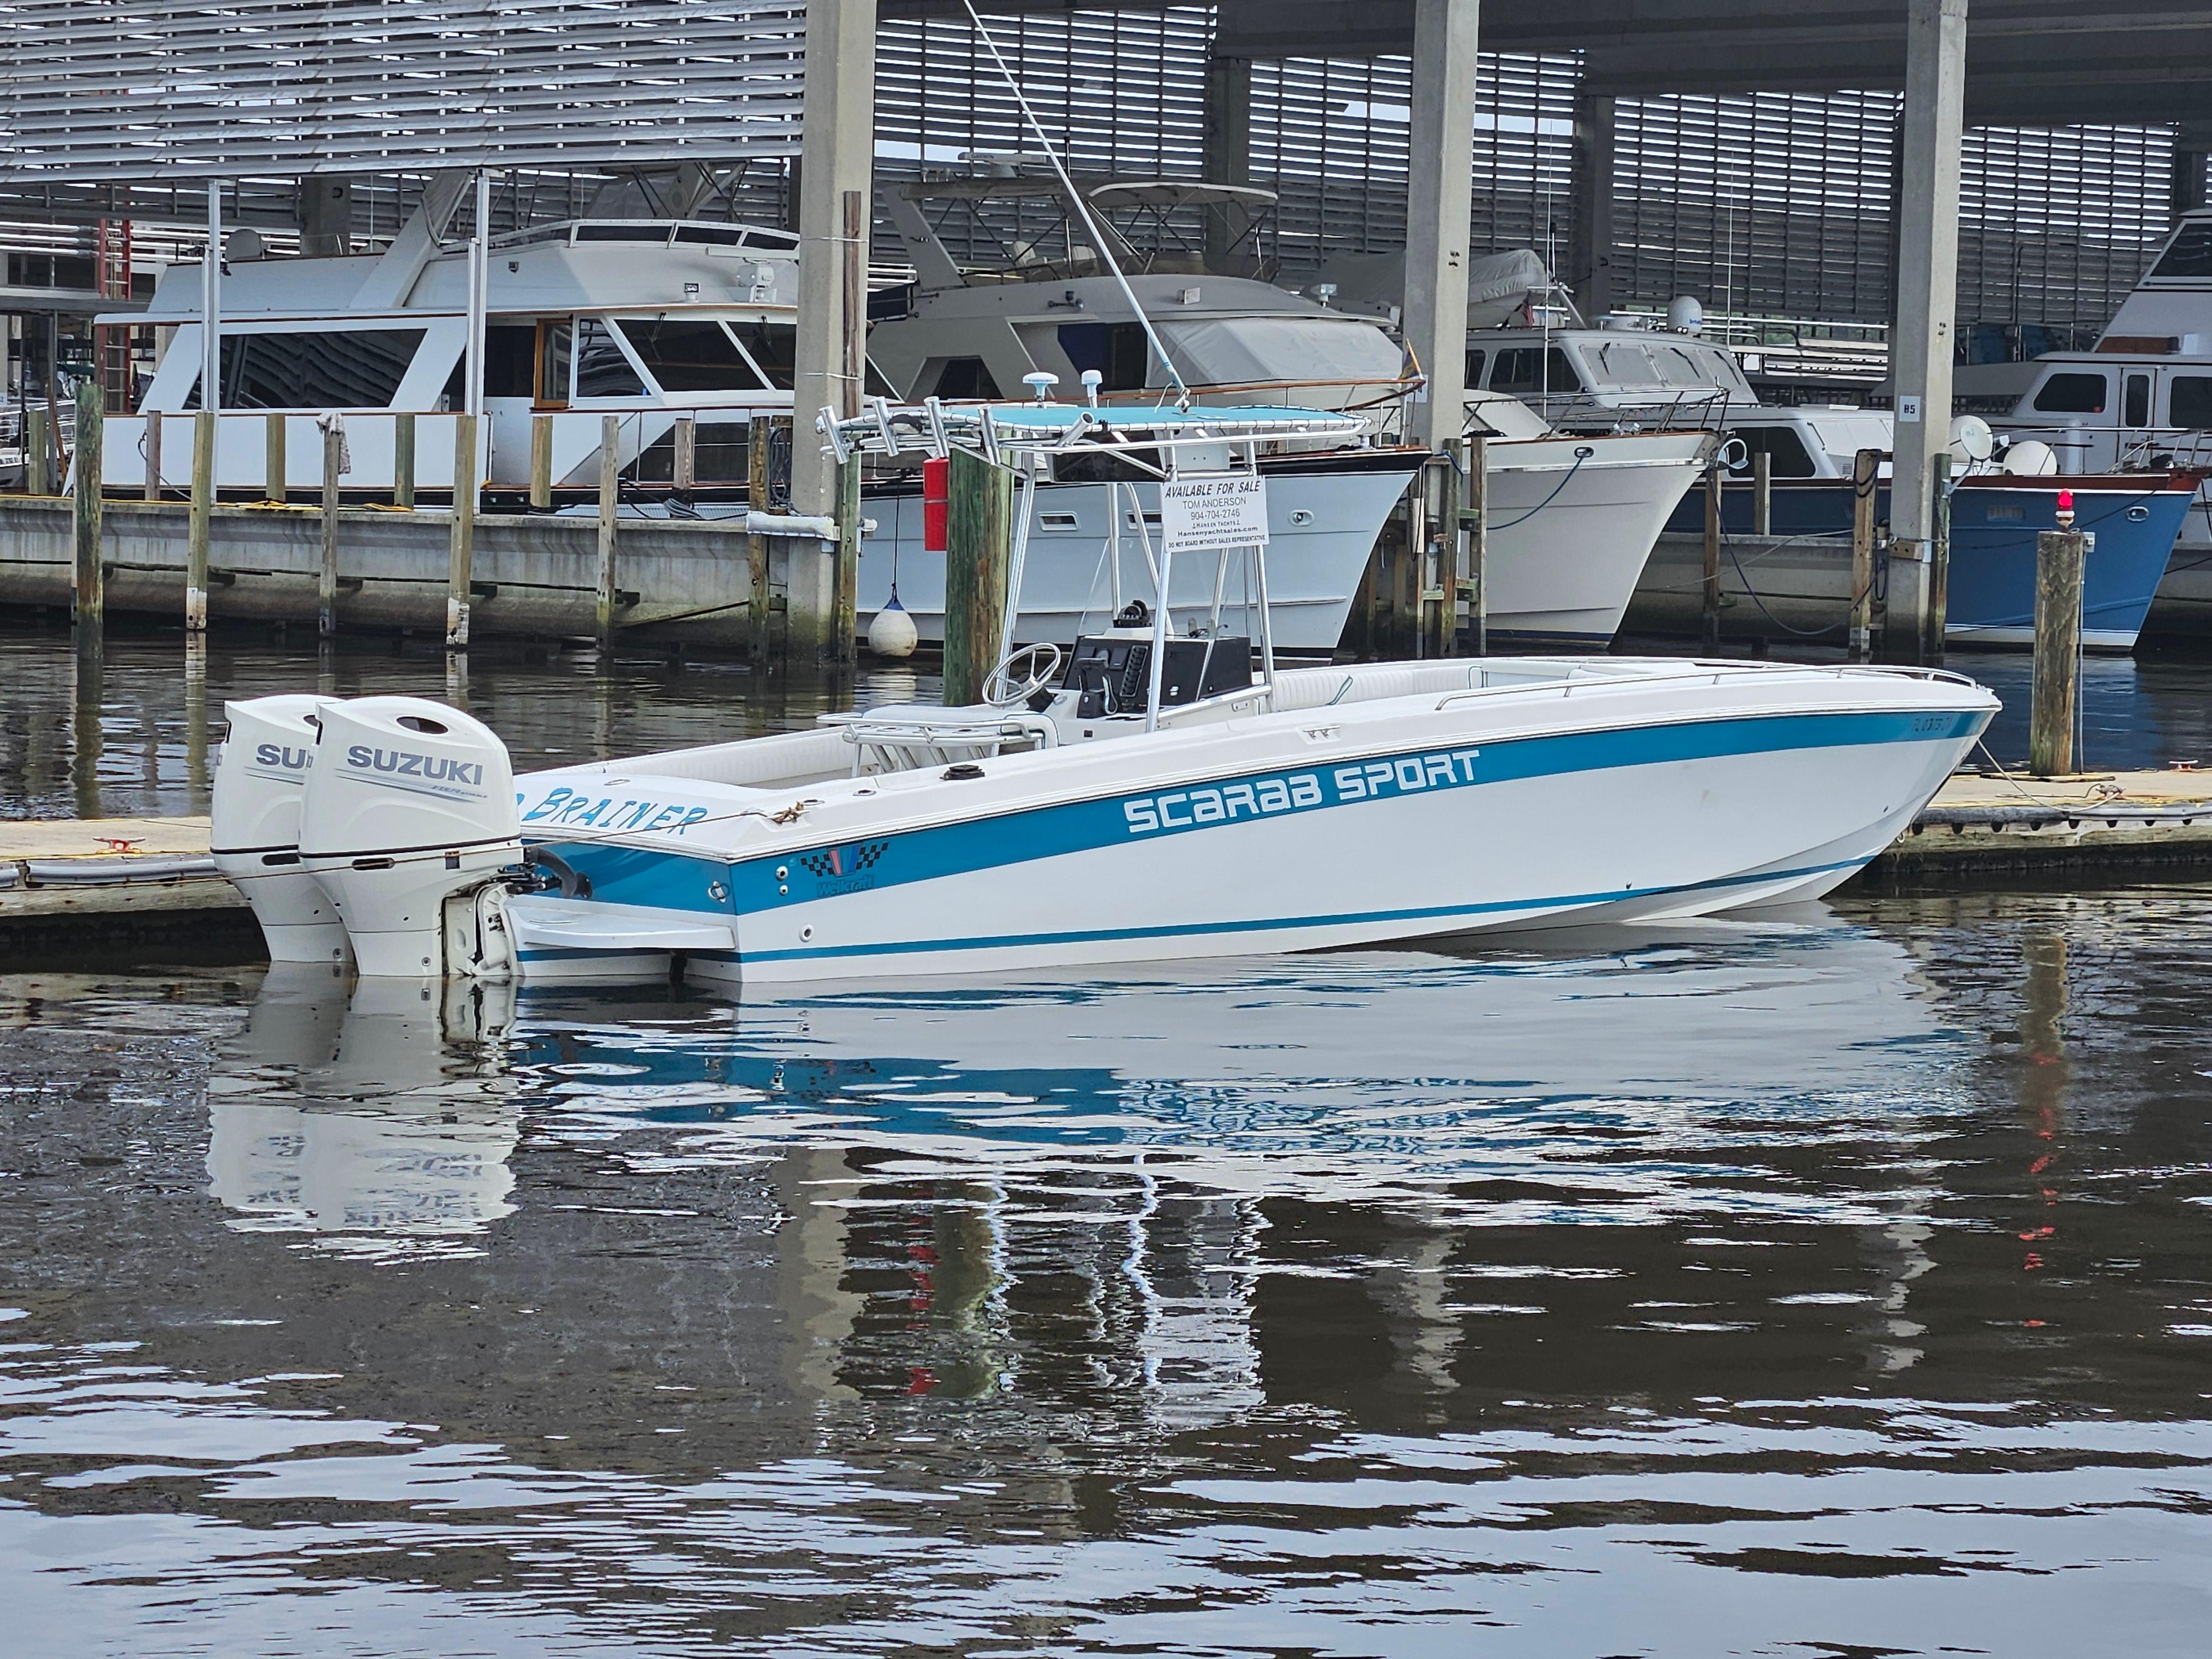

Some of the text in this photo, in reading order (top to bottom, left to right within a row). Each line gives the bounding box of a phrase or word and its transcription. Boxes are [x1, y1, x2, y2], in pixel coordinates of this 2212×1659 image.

[1165, 481, 1260, 498] AVAILABLE FOR SALE
[1183, 497, 1246, 509] TOM ANDERSON
[1191, 508, 1240, 520] 904-704-2746
[1177, 526, 1258, 537] Hansenyachtsales.com
[347, 745, 483, 785] SUZUKI
[1334, 750, 1480, 800] SPORT
